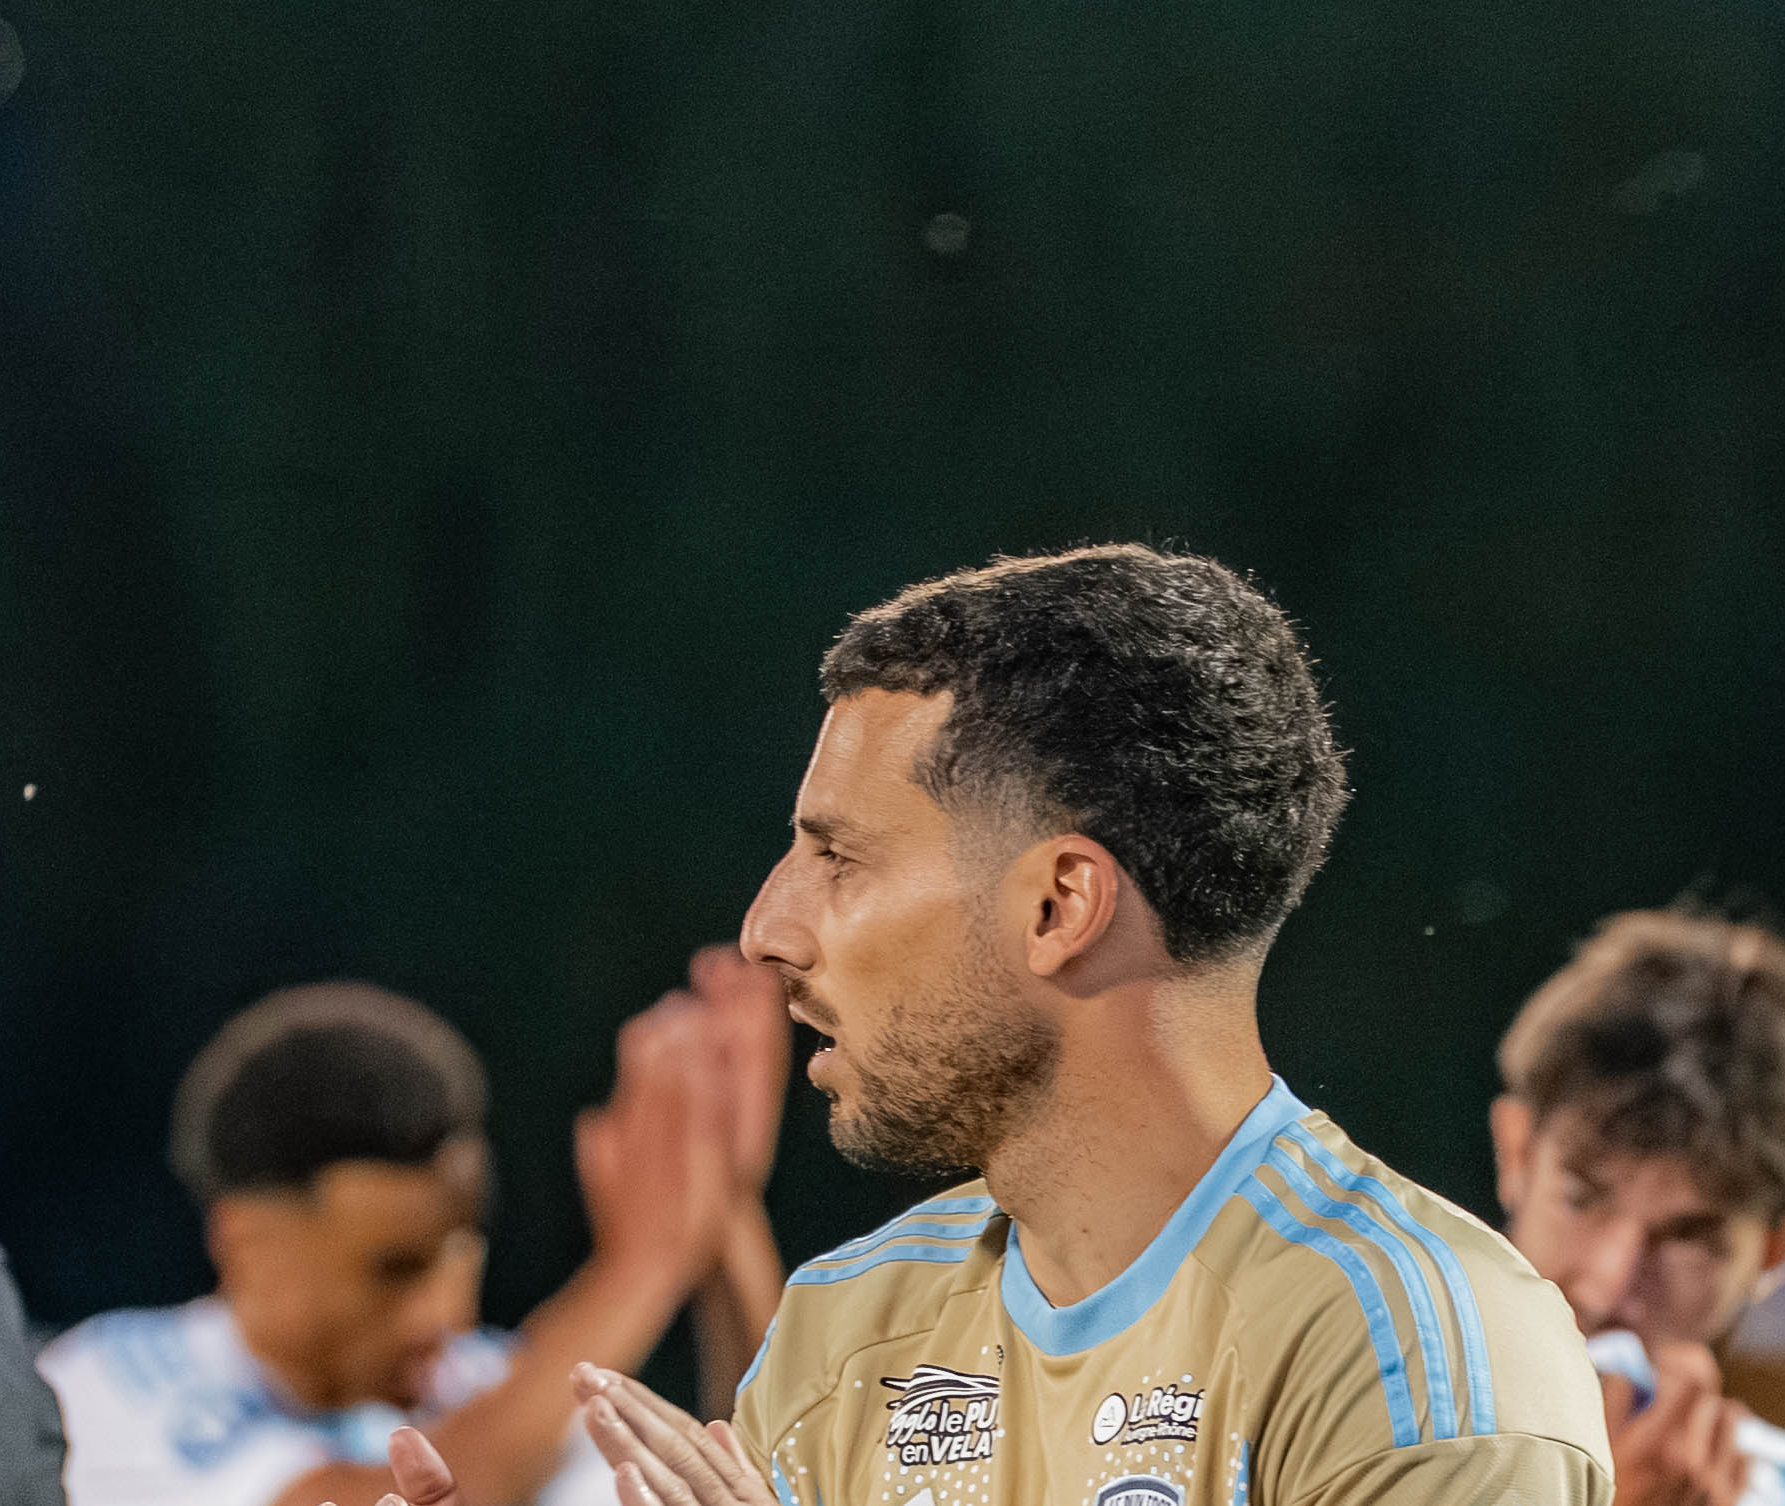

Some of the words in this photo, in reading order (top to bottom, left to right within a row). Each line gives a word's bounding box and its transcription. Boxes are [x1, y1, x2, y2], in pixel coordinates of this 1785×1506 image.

[938, 1400, 965, 1433] le
[963, 1399, 1000, 1432] PU
[1146, 1384, 1204, 1423] Régi
[900, 1442, 930, 1466] en
[929, 1430, 995, 1464] VELA
